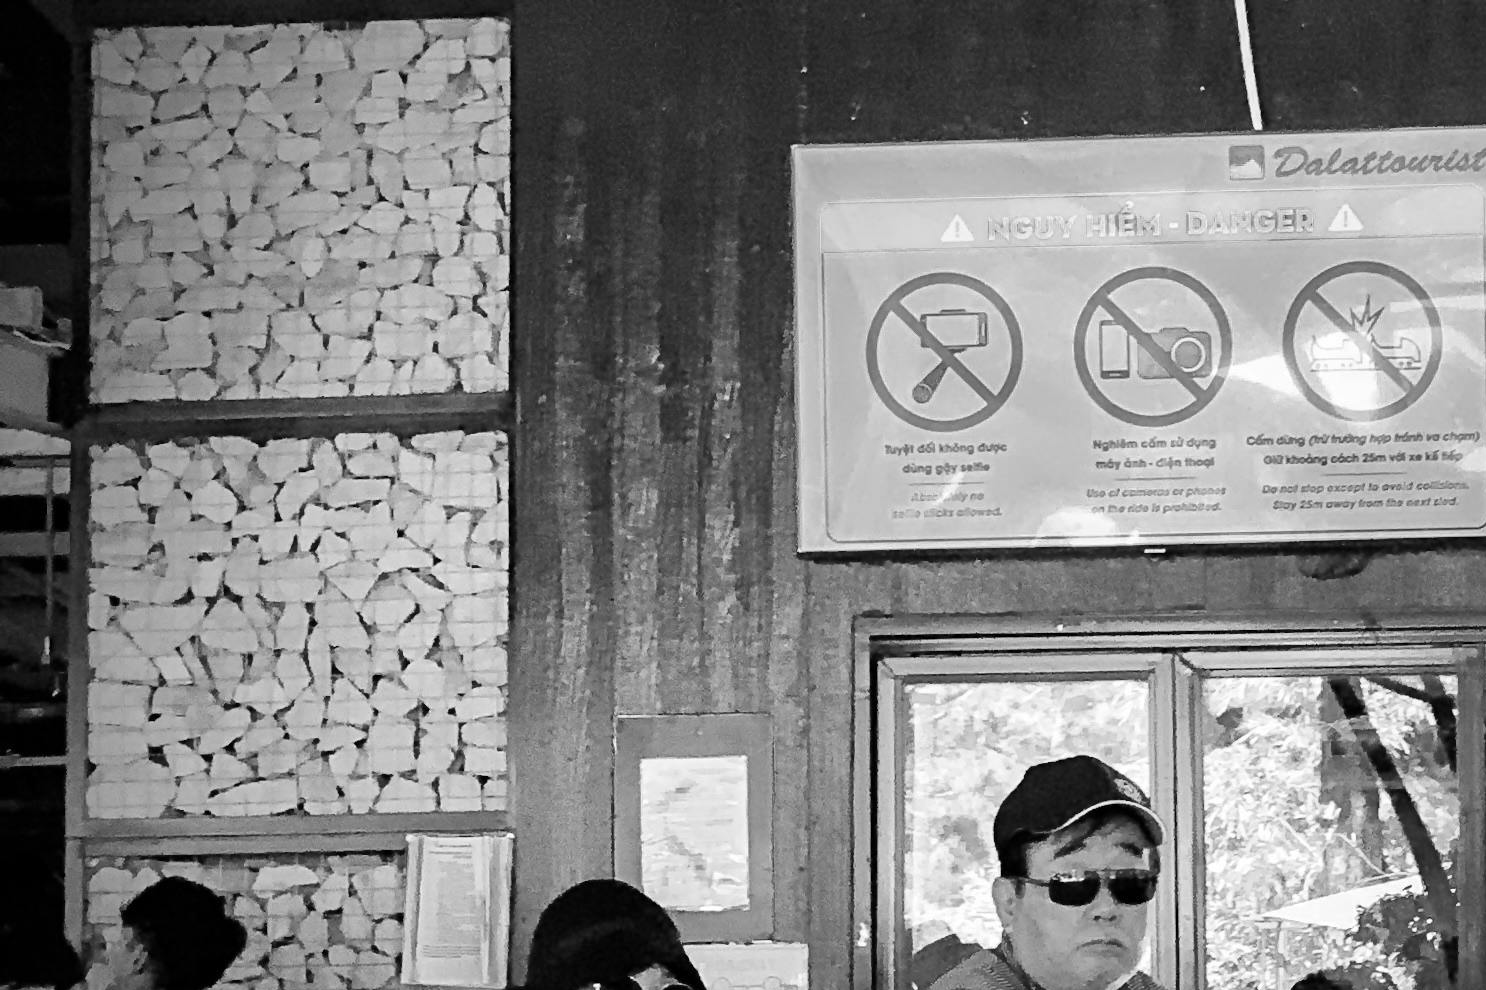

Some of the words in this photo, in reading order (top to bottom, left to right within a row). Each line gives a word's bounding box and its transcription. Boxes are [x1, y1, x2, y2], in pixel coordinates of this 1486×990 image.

[987, 215, 1077, 241] NGUY
[1086, 201, 1160, 238] HIỂM
[1186, 208, 1314, 236] DANGER
[1426, 433, 1440, 441] va
[885, 444, 914, 456] Tuyệt
[917, 441, 936, 453] đối
[939, 442, 974, 455] không
[978, 443, 1007, 454] được
[1093, 438, 1137, 451] Nghiêm
[1141, 436, 1167, 448] cấm
[1186, 437, 1216, 449] dụng
[1096, 458, 1120, 470] máy
[1124, 457, 1147, 468] ảnh
[1185, 457, 1215, 468] thoại
[1331, 453, 1359, 464] cách
[1362, 452, 1386, 462] 25m
[902, 463, 932, 475] dùng
[935, 463, 957, 475] gậy
[1327, 483, 1365, 493] except
[1368, 483, 1379, 491] to
[1382, 482, 1414, 491] avoid
[1326, 501, 1356, 510] away
